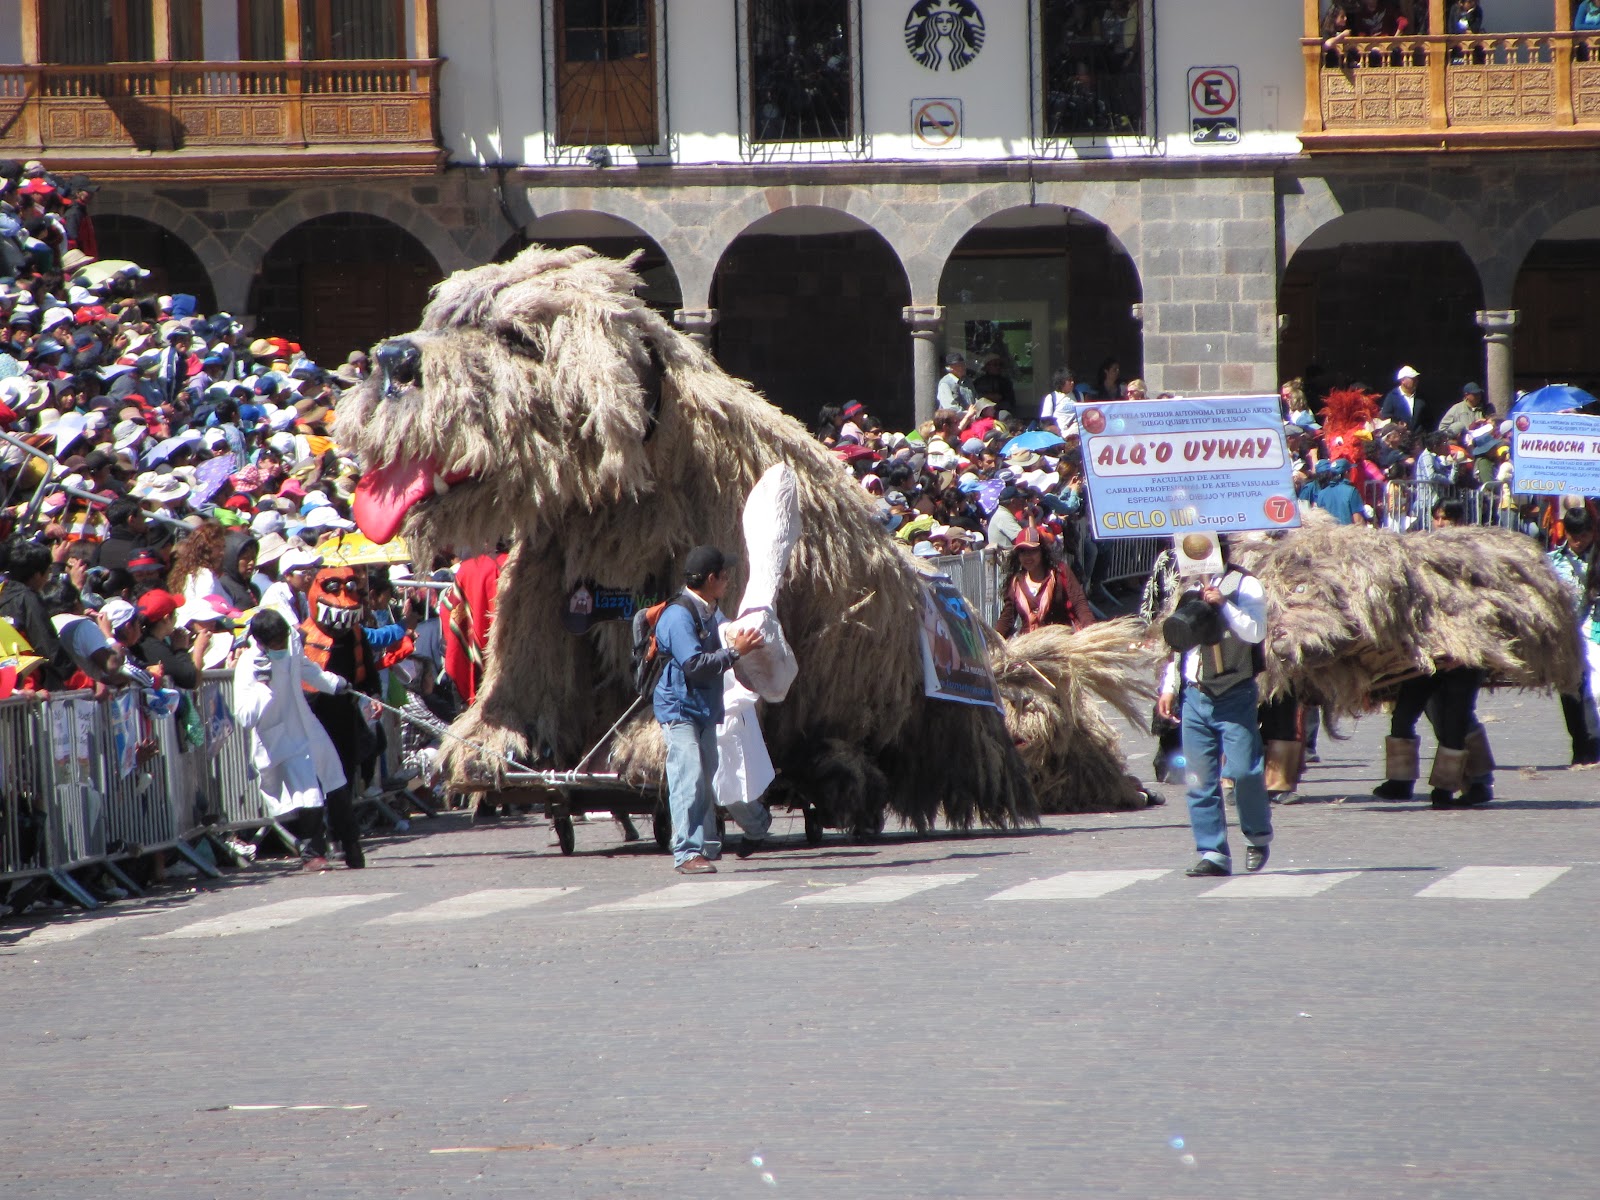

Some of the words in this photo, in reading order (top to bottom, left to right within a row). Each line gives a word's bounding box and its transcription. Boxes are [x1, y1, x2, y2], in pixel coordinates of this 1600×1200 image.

[1204, 79, 1223, 105] E
[1139, 411, 1175, 419] SUPERIOR
[1175, 409, 1215, 417] AUTONOMA
[1226, 407, 1252, 415] BELLAS
[1098, 441, 1174, 466] ALQ'O
[1183, 436, 1273, 462] UYWAY
[1521, 439, 1585, 453] WIRAQOCHA
[1151, 475, 1195, 484] FACULTAD
[1197, 474, 1209, 482] DE
[1210, 473, 1231, 481] ARTE
[1518, 479, 1555, 491] CICLO
[1557, 480, 1567, 492] V
[1105, 487, 1145, 495] CARRERA
[1202, 482, 1214, 490] DE
[1215, 481, 1241, 489] ARTES
[1241, 479, 1280, 488] VISUALES
[1189, 492, 1219, 501] DIBUJO
[1227, 490, 1263, 499] PINTURA
[1272, 500, 1288, 519] 7
[1102, 510, 1166, 530] CICLO
[1198, 515, 1235, 527] Grupo
[1237, 512, 1247, 523] B
